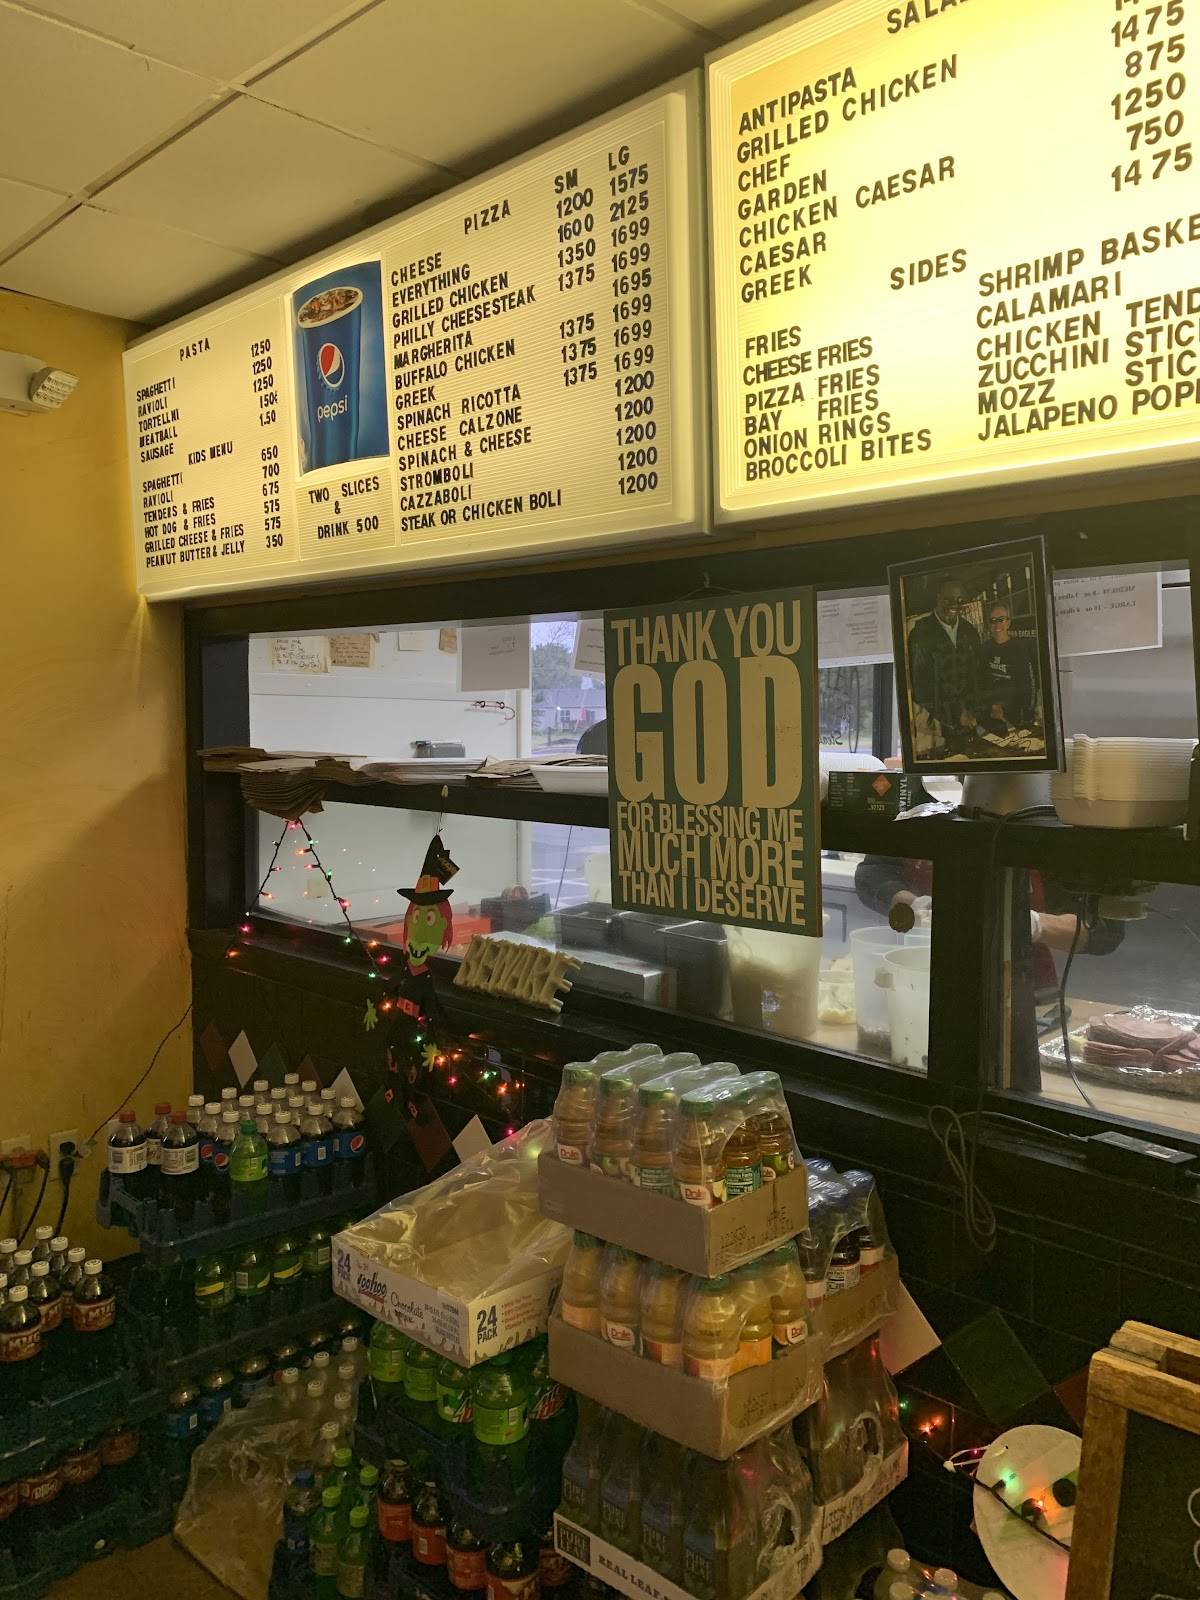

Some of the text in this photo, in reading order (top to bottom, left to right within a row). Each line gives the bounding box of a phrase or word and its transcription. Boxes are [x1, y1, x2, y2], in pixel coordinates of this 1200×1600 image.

[887, 0, 968, 34] SAL
[1111, 0, 1185, 48] 1475
[1125, 33, 1186, 78] 875
[737, 54, 958, 164] GRILLED CHICKEN
[738, 66, 857, 136] ANTIPASTA
[1111, 72, 1187, 121] 1250
[1126, 109, 1184, 151] 750
[554, 145, 630, 194] SM LG
[738, 154, 791, 193] CHEF
[1111, 142, 1192, 193] 1475
[464, 200, 511, 235] PIZZA
[738, 169, 828, 222] GARDEN
[739, 155, 956, 249] CHICKEN CAESAR
[391, 164, 648, 287] CHEESE 1200 1575
[392, 190, 649, 307] EVERYTHING 1600 2125
[392, 216, 650, 328] GRILLED CHICKEN 1350 1699
[740, 231, 828, 277] CAESAR
[890, 249, 968, 291] SIDES
[978, 247, 1085, 297] SHRIMP
[393, 243, 650, 349] PHILLY CHEESESTEAK 1375 1699
[741, 264, 813, 304] GREEK
[976, 271, 1121, 329] CALAMARI
[393, 267, 651, 370] MARGHERITA 1695
[395, 294, 651, 390] BUFFALO CHICKEN 1375 1699
[745, 325, 802, 359] FRIES
[976, 310, 1101, 362] CHICKEN
[136, 339, 271, 402] SPAGHETTI 1250
[180, 337, 210, 361] PASTA
[395, 319, 652, 410] GREEK 1375 1699
[743, 336, 873, 387] CHEESE FRIES
[977, 317, 1200, 389] ZUCCHINI STIC
[138, 357, 272, 417] RAVIOLI 1250
[253, 374, 274, 392] 1250
[397, 344, 655, 430] SPINACH RICOTTA 1375 1699
[745, 364, 881, 414] PIZZA FRIES
[977, 378, 1056, 415] MOZZ
[317, 395, 348, 422] pepsi
[397, 370, 655, 451] CHEESE CALZONE 1200
[744, 389, 879, 436] BAY FRIES
[977, 378, 1200, 442] JALAPENO POP
[139, 426, 178, 448] MEATBALL
[140, 443, 174, 463] SAUSAGE
[188, 441, 233, 465] KIDS MENU
[399, 396, 654, 472] SPINACH & CHEESE 1200
[400, 421, 657, 492] STROMBOLI 1200
[744, 412, 891, 459] ONION RINGS
[745, 429, 932, 482] BROCCOLI BITES
[142, 445, 278, 493] SPAGHETTI 650
[143, 463, 280, 508] RAVIOLI 700
[308, 476, 380, 504] TWO SLICES
[400, 446, 658, 512] CAZZABOLI 1200
[144, 499, 280, 538] HOT DOG & FRIES 575
[182, 503, 187, 515] &
[191, 497, 215, 513] FRIES
[262, 481, 279, 497] 675
[334, 501, 341, 514] &
[401, 471, 658, 532] STEAK OR CHICKEN BOLI 1200
[144, 515, 281, 554] GRILLED CHEESE & FRIES 575
[146, 533, 283, 568] PEANUT BUTTER & JELLY 350
[317, 515, 379, 539] DRINK 500
[611, 609, 719, 665] THANK
[725, 599, 801, 659] YOU
[613, 655, 803, 809] GOD
[616, 801, 804, 842] FOR BLESSING ME
[618, 831, 805, 889] MUCH MORE
[619, 870, 806, 926] THAN I DESERVE
[336, 1249, 351, 1273] 24
[476, 1304, 498, 1335] 24
[477, 1327, 498, 1345] PACK
[599, 1554, 659, 1599] REAL LEAF
